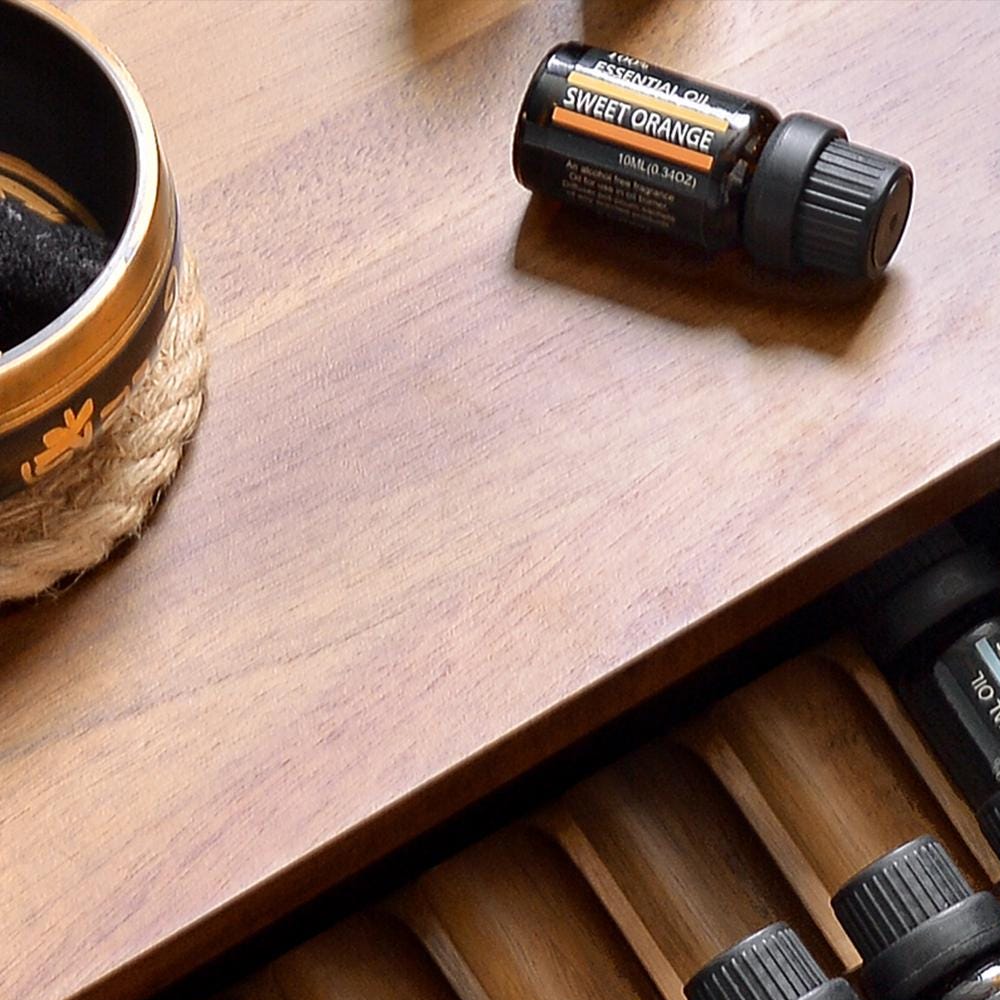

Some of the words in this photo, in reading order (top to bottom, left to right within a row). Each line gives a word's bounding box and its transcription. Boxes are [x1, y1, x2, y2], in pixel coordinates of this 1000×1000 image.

[595, 61, 679, 97] ESSENTIAL
[683, 89, 710, 105] OIL
[563, 87, 631, 125] SWEET
[631, 109, 715, 151] ORANGE
[619, 153, 697, 189] 10ML(0.34OZ)
[971, 670, 996, 700] OIL
